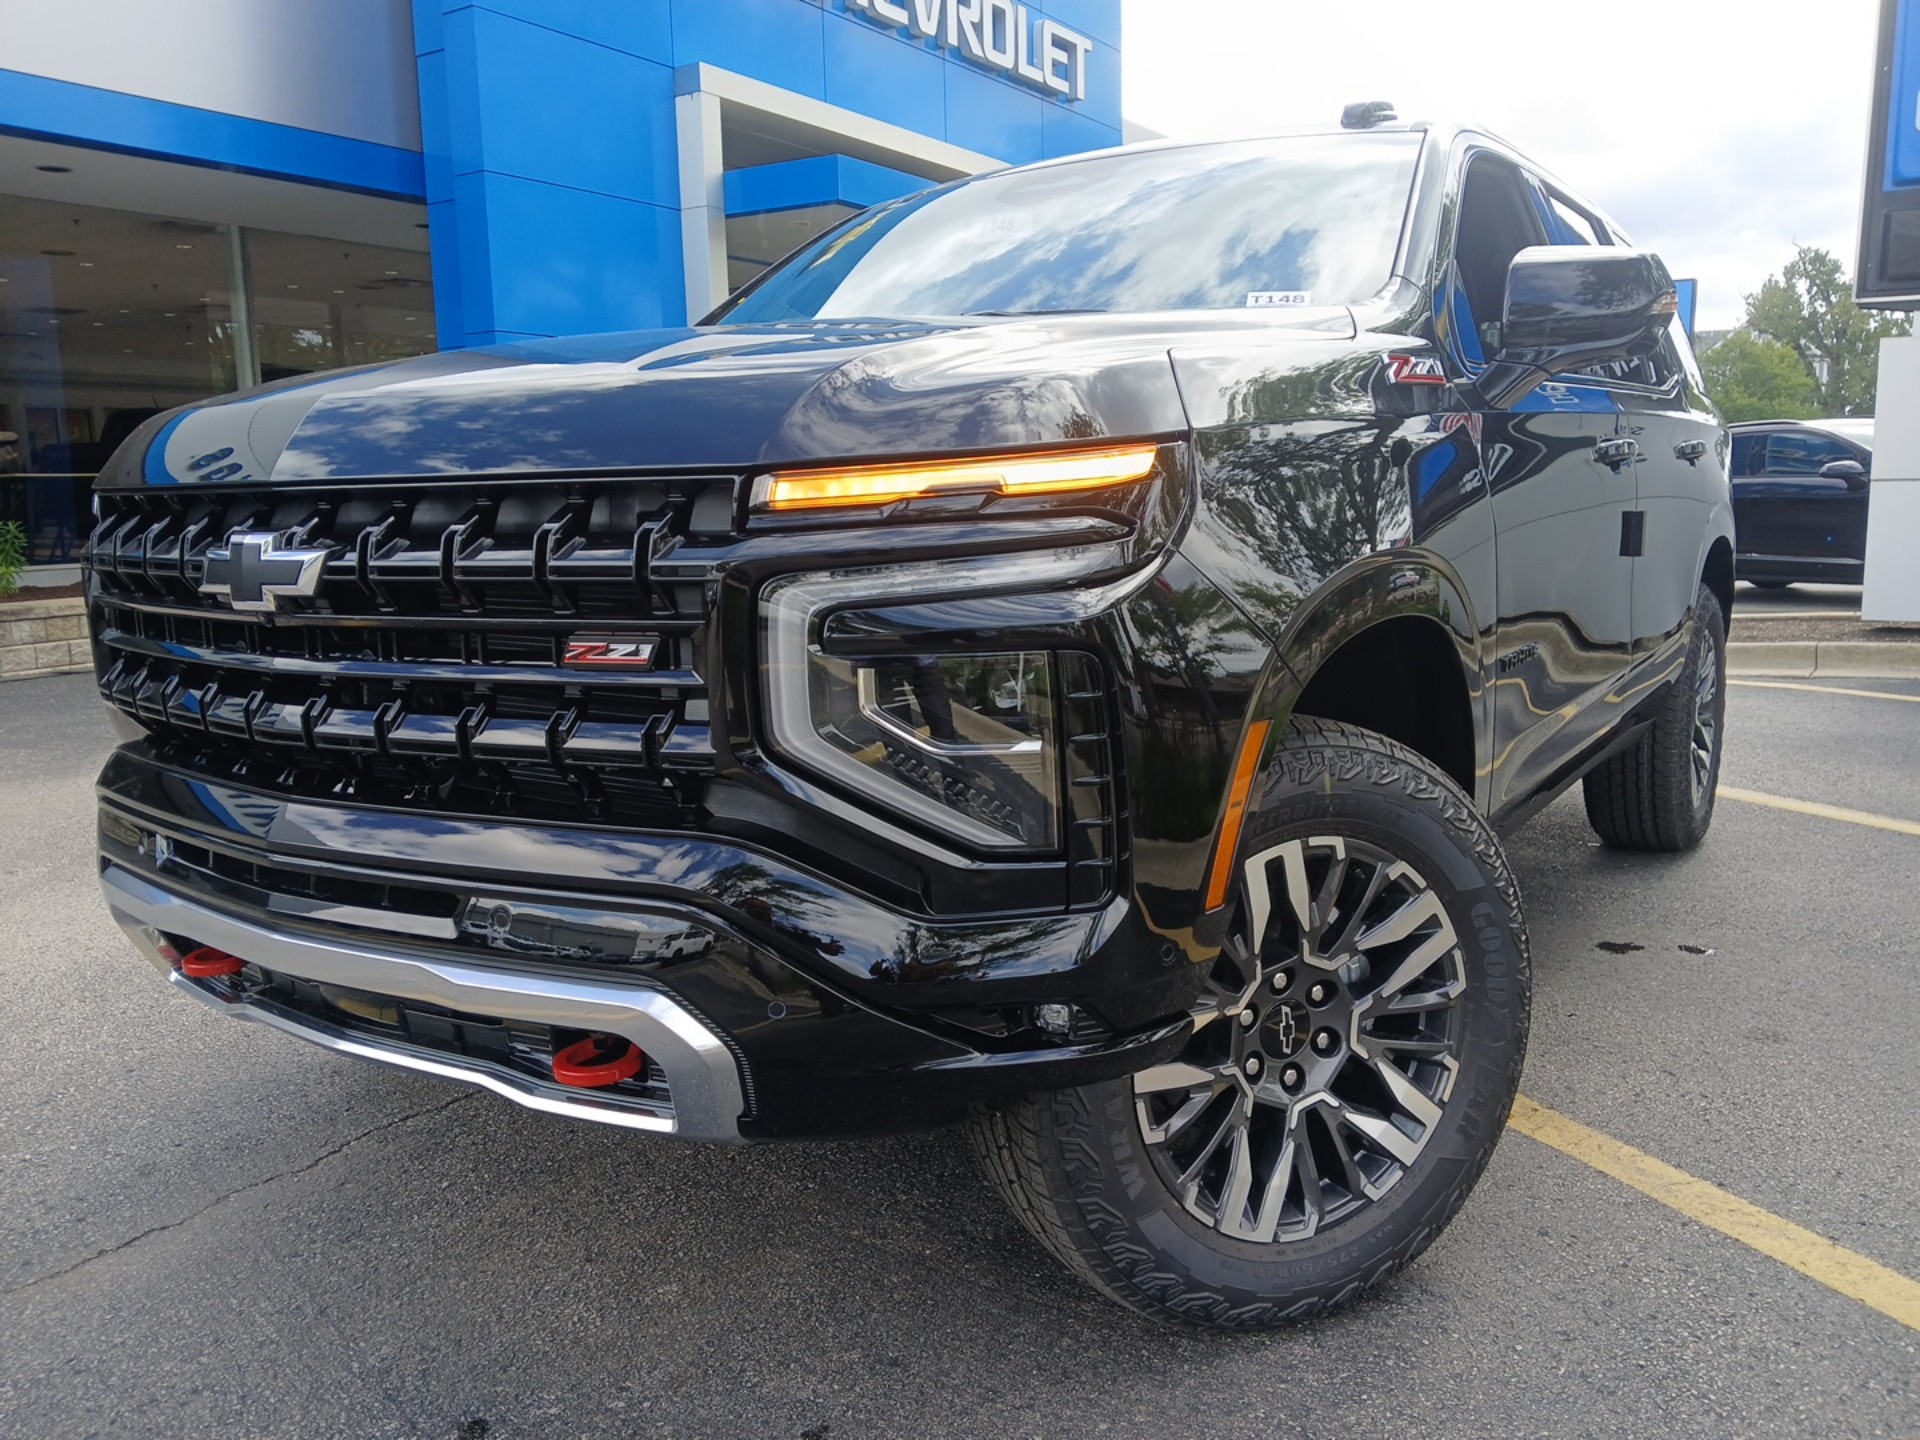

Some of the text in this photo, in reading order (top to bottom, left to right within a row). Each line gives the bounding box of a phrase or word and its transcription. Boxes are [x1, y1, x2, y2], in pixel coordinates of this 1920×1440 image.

[1250, 294, 1306, 305] T148
[1381, 353, 1447, 385] Z71
[563, 641, 654, 665] Z71
